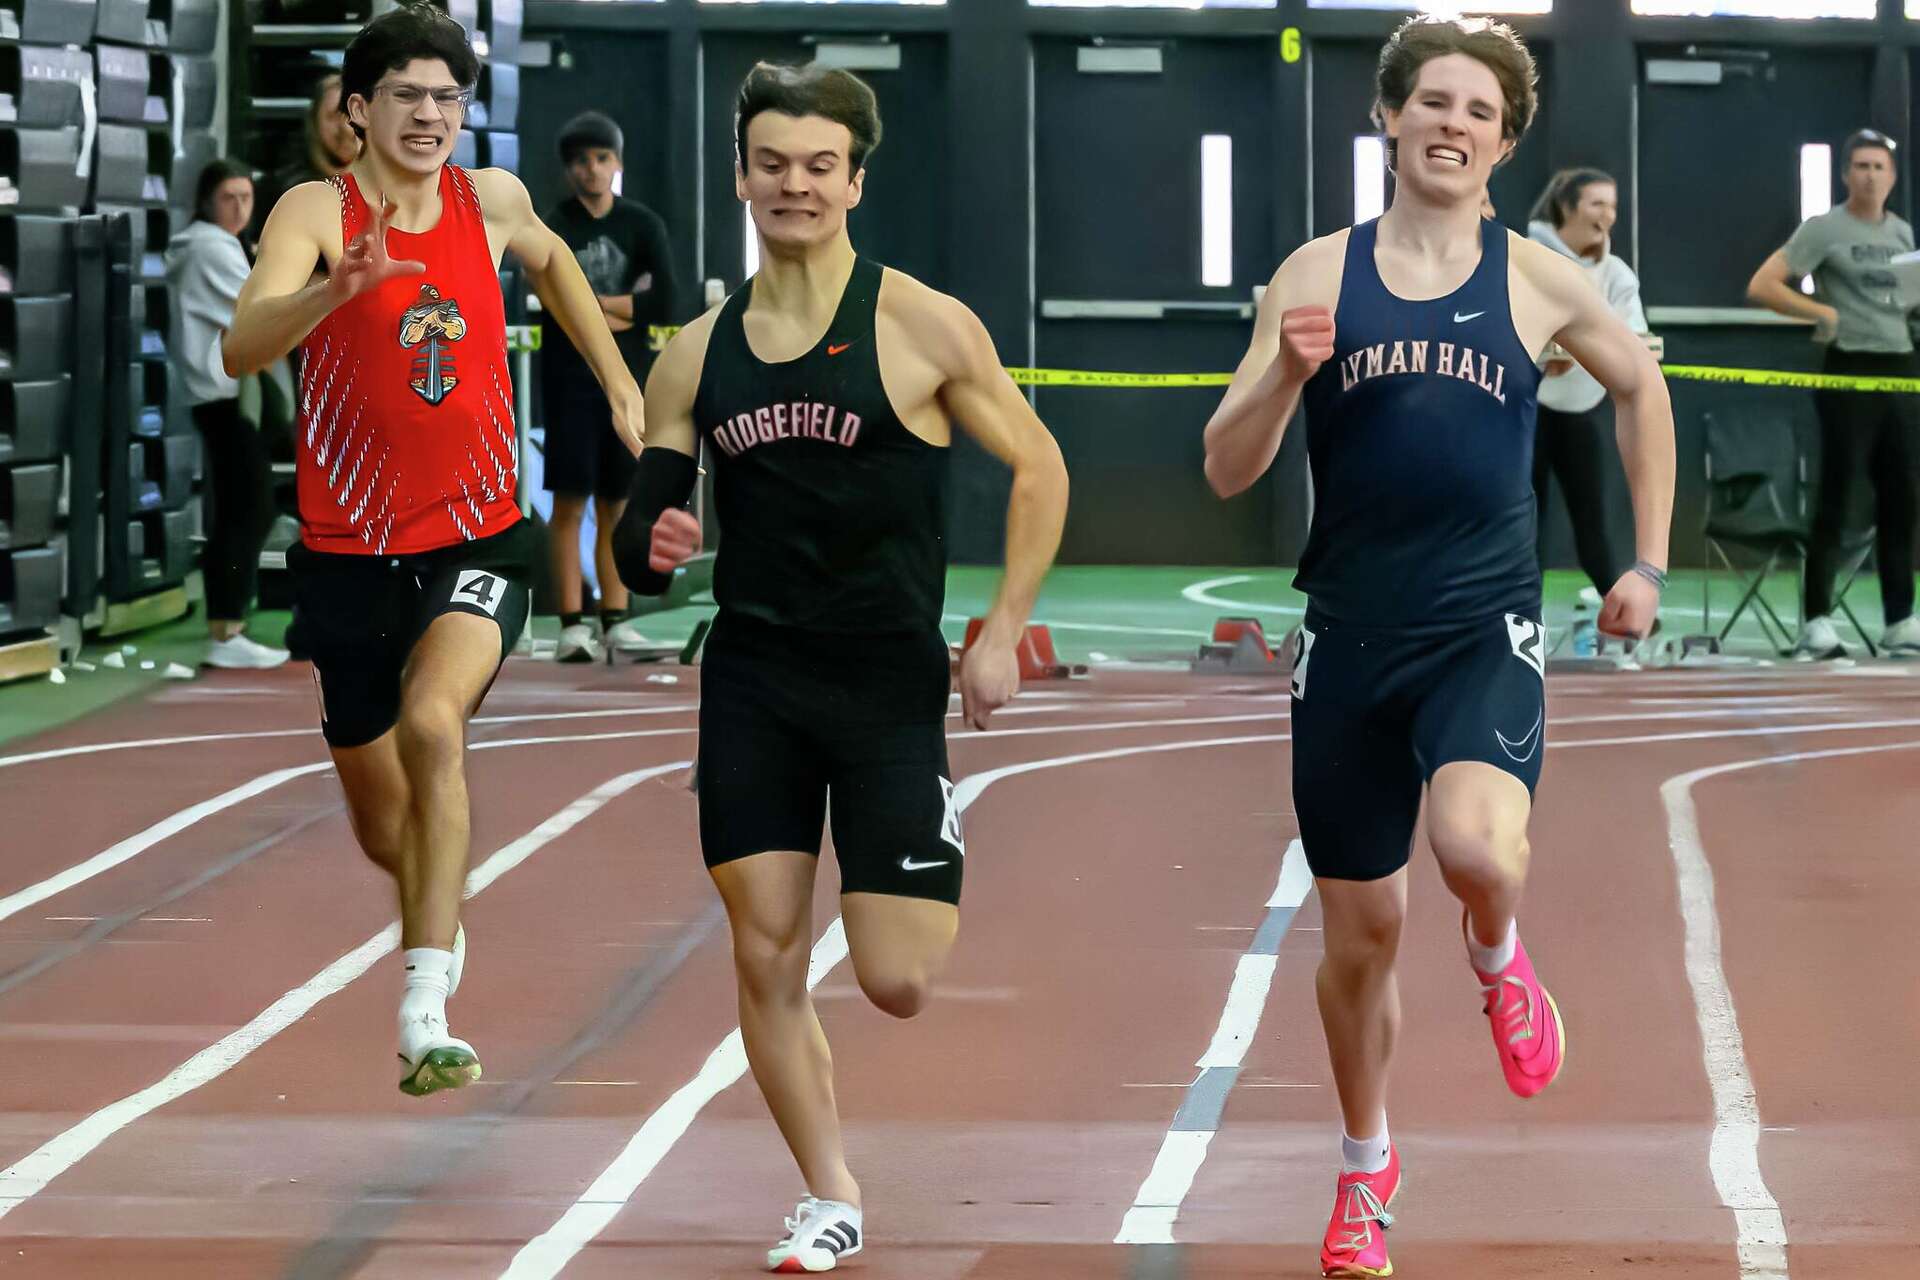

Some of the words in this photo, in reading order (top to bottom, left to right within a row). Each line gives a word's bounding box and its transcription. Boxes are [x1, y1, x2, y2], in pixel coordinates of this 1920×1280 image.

[1281, 27, 1300, 63] 6
[1341, 341, 1428, 391] LYMAN
[1437, 342, 1506, 406] HALL
[713, 402, 861, 457] RIDGEFIELD
[459, 575, 495, 606] 4
[1512, 616, 1541, 669] 2
